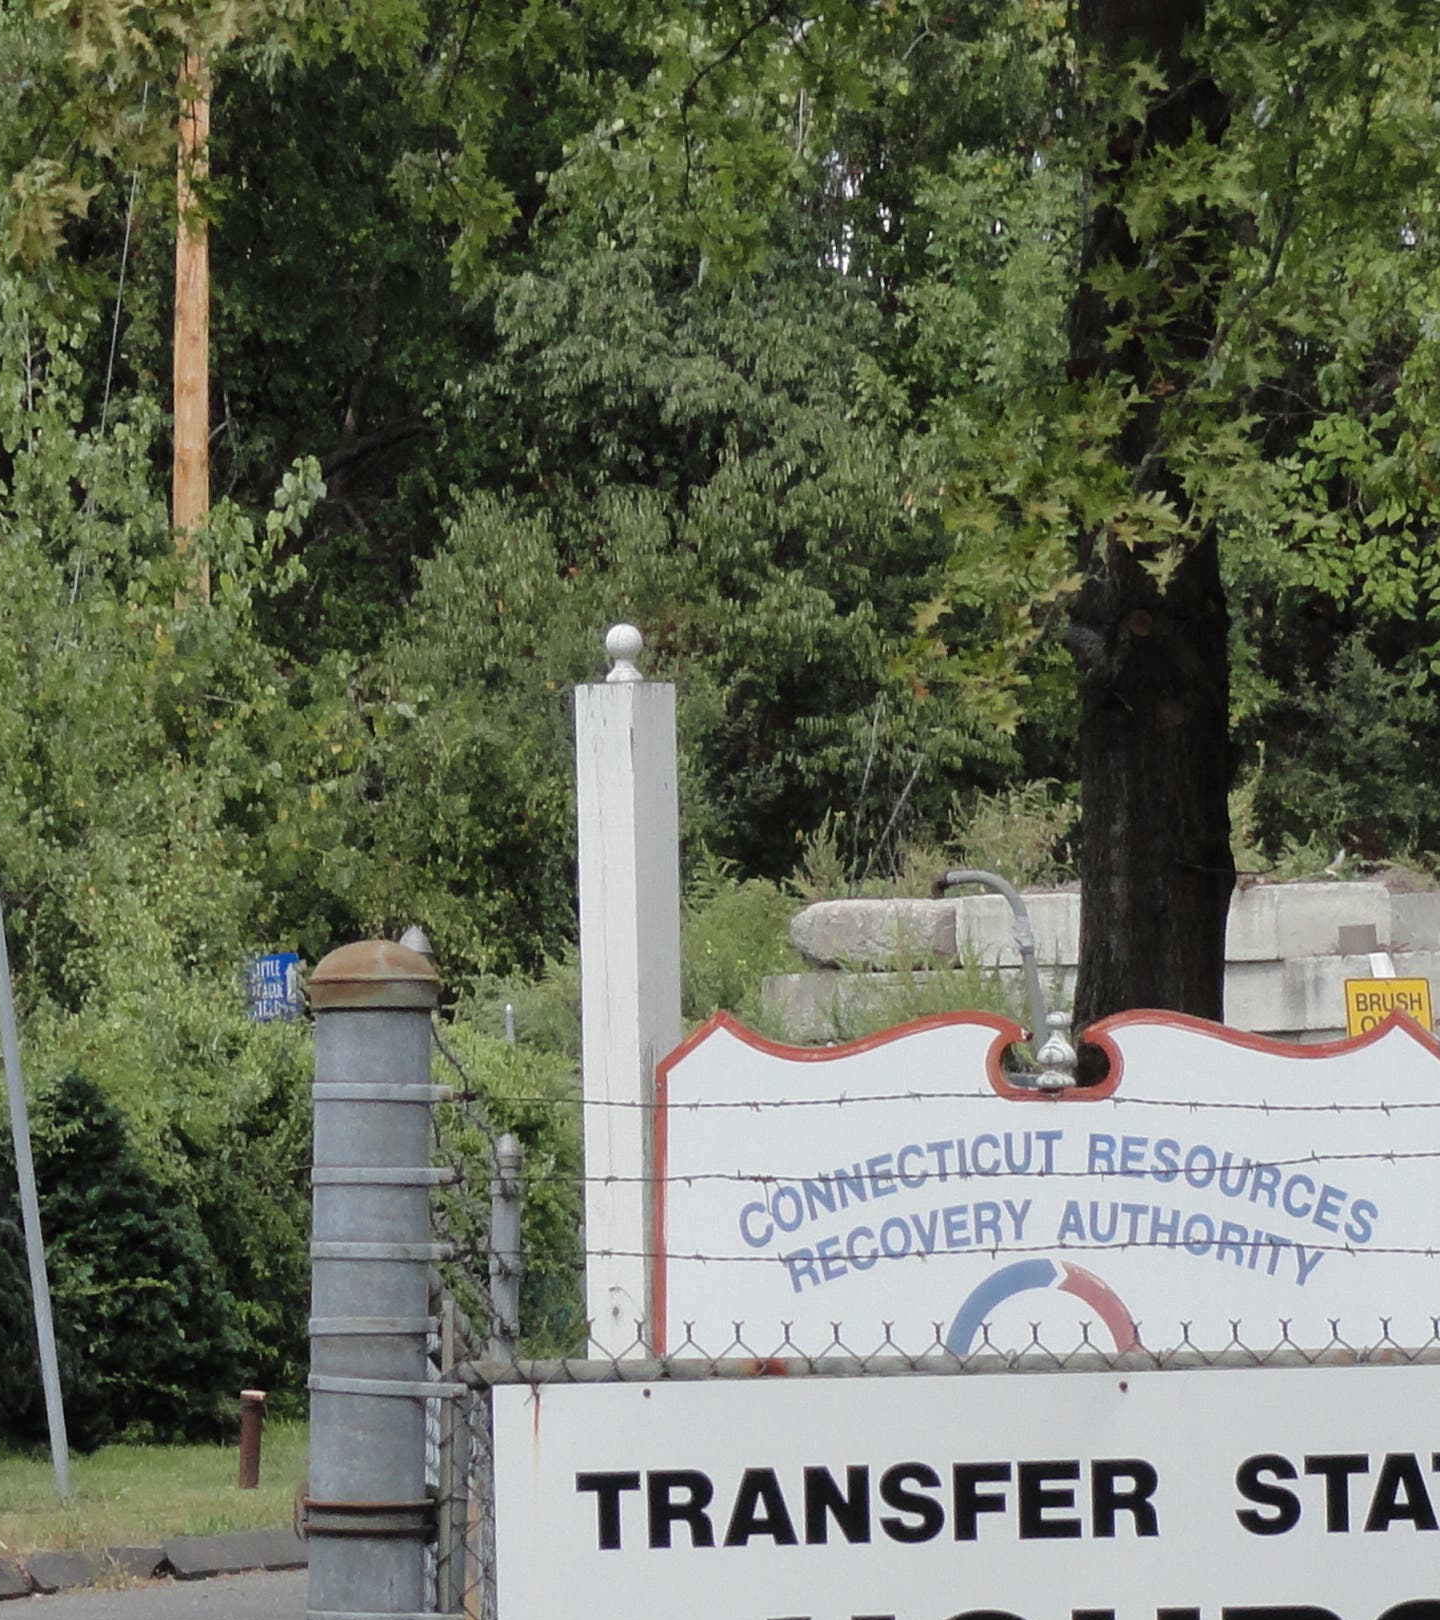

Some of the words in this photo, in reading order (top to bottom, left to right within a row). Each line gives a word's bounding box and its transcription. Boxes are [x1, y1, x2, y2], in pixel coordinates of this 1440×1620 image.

[1354, 991, 1423, 1013] BRUSH
[739, 1130, 1063, 1248] CONNECTICUT
[1087, 1133, 1378, 1244] RESOURCES
[784, 1199, 1032, 1293] RECOVERY
[1057, 1199, 1326, 1287] AUTHORITY
[575, 1458, 1162, 1551] TRANSFER
